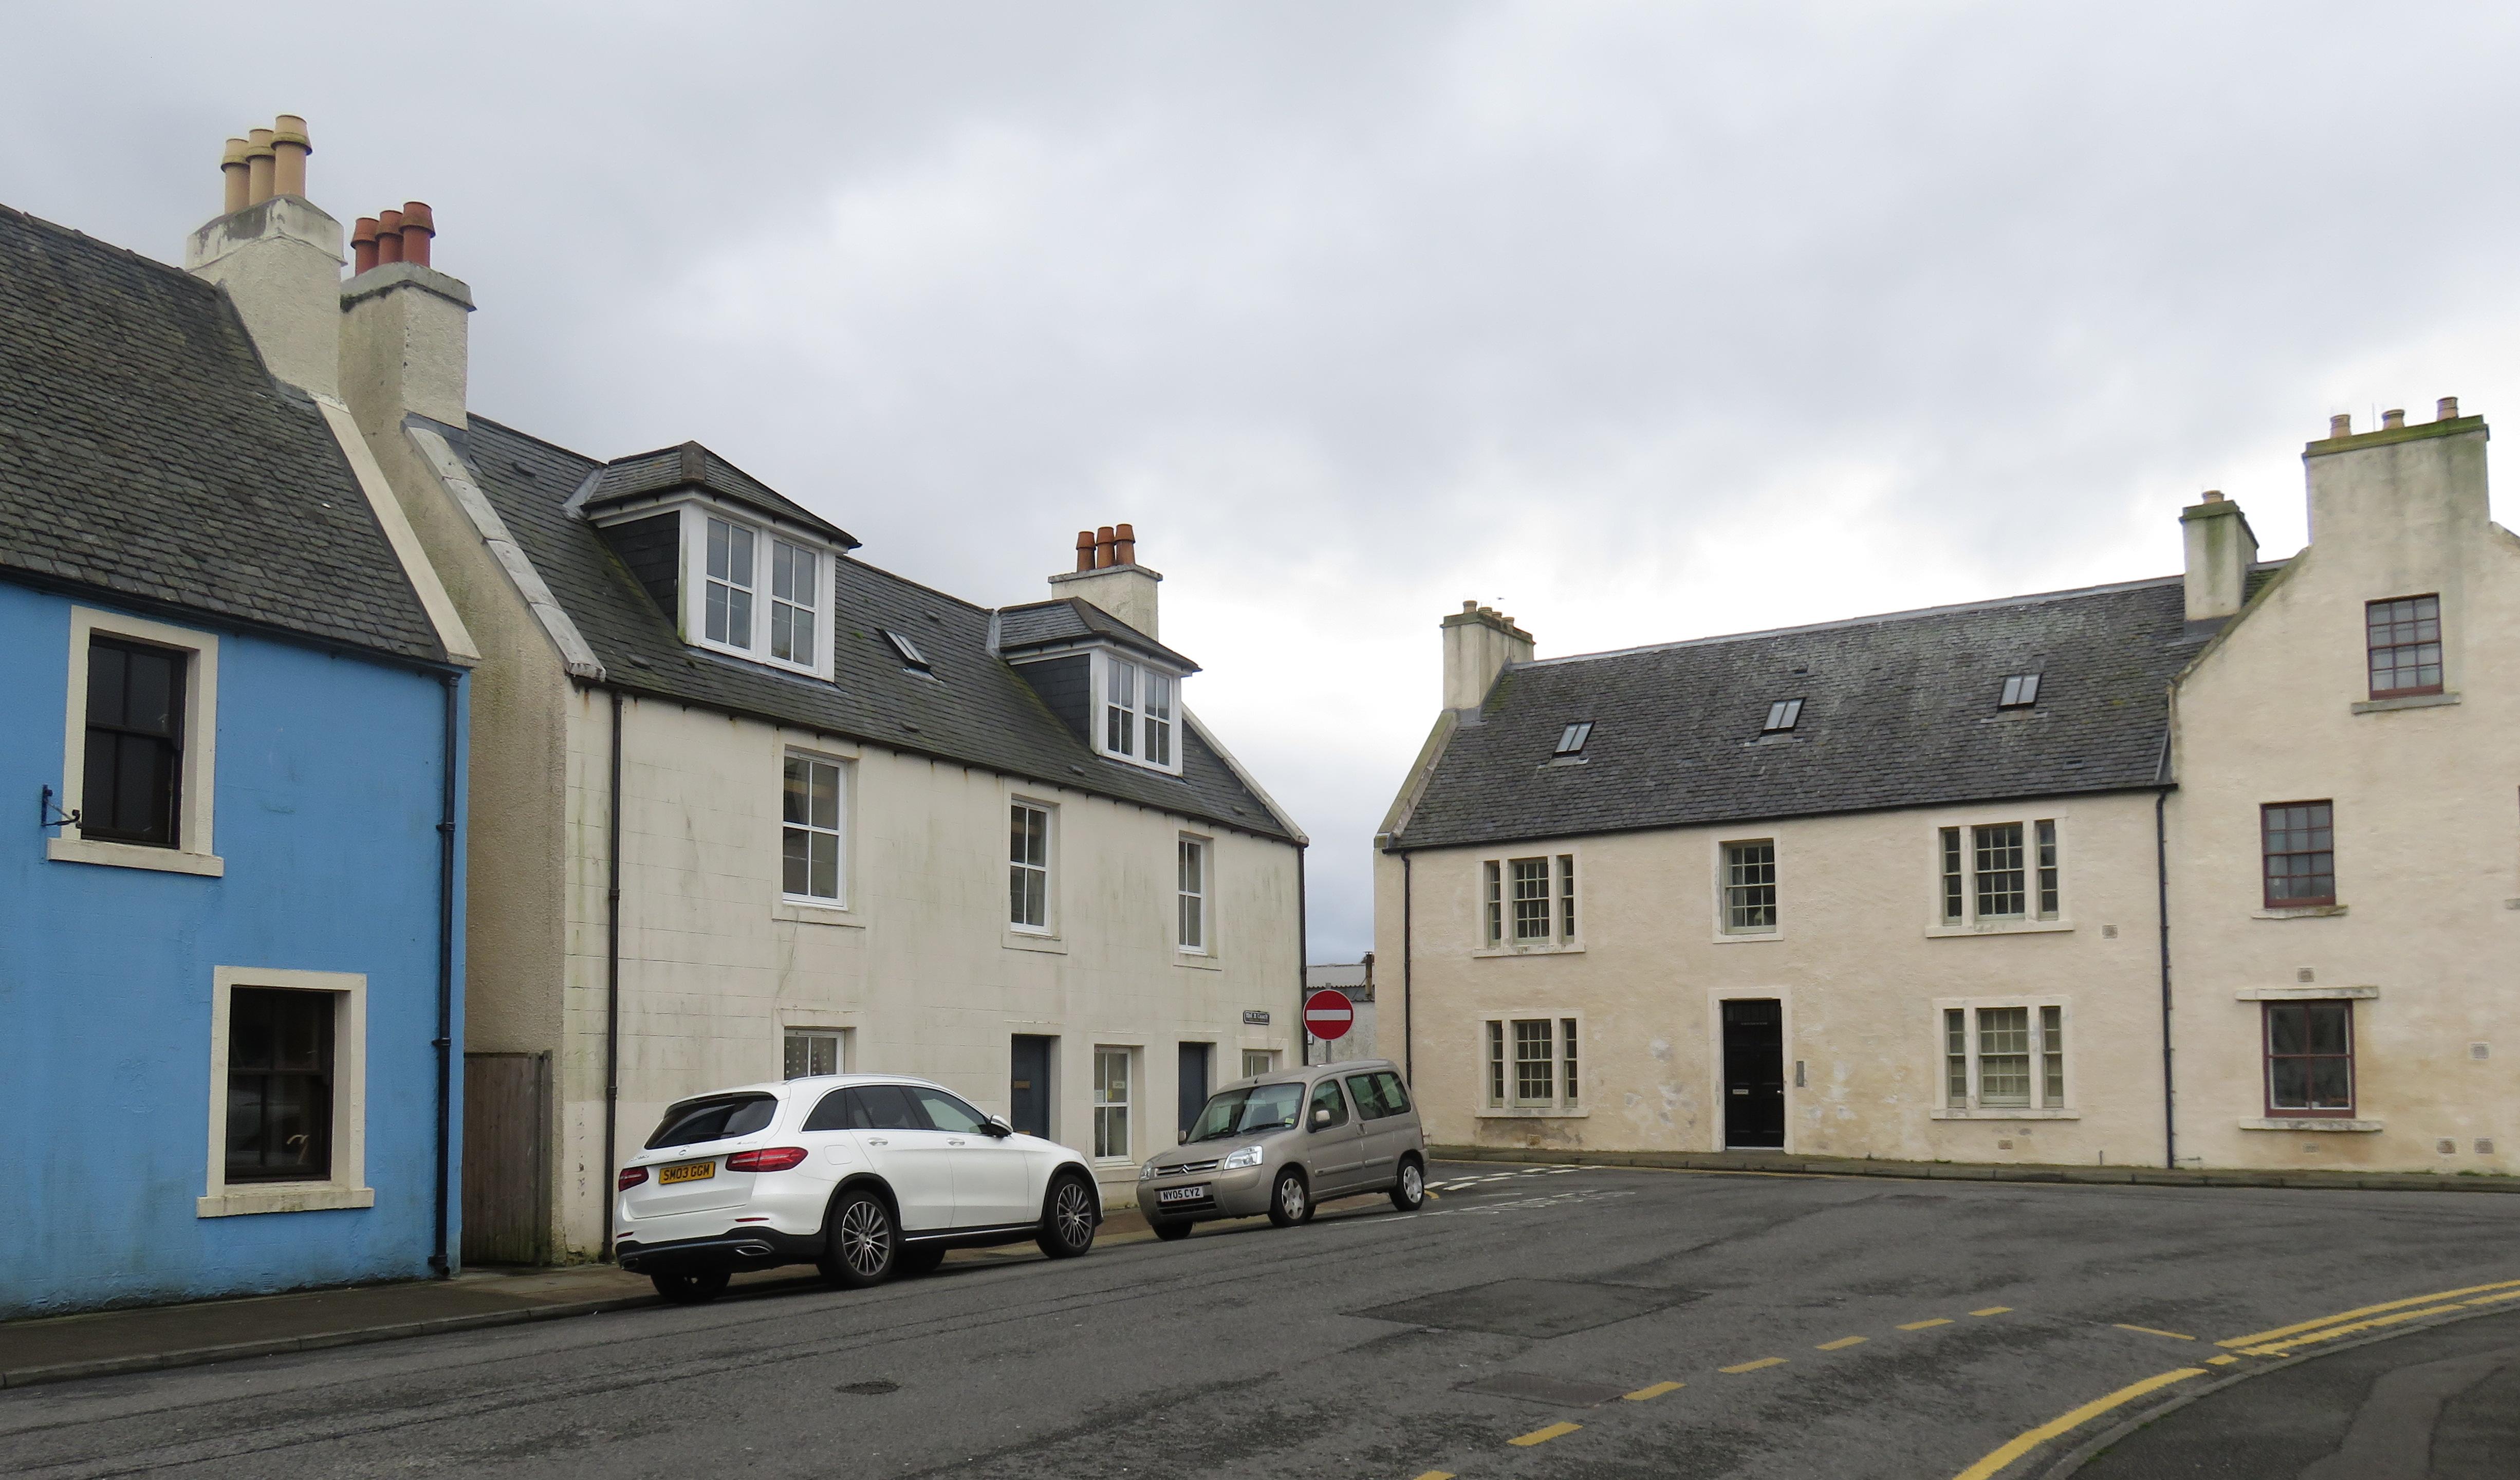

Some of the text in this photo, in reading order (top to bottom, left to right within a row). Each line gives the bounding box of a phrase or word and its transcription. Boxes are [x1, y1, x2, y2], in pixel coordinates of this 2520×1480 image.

[663, 1164, 710, 1181] SM03 GGM
[1163, 1188, 1200, 1200] NY05 CYZ
